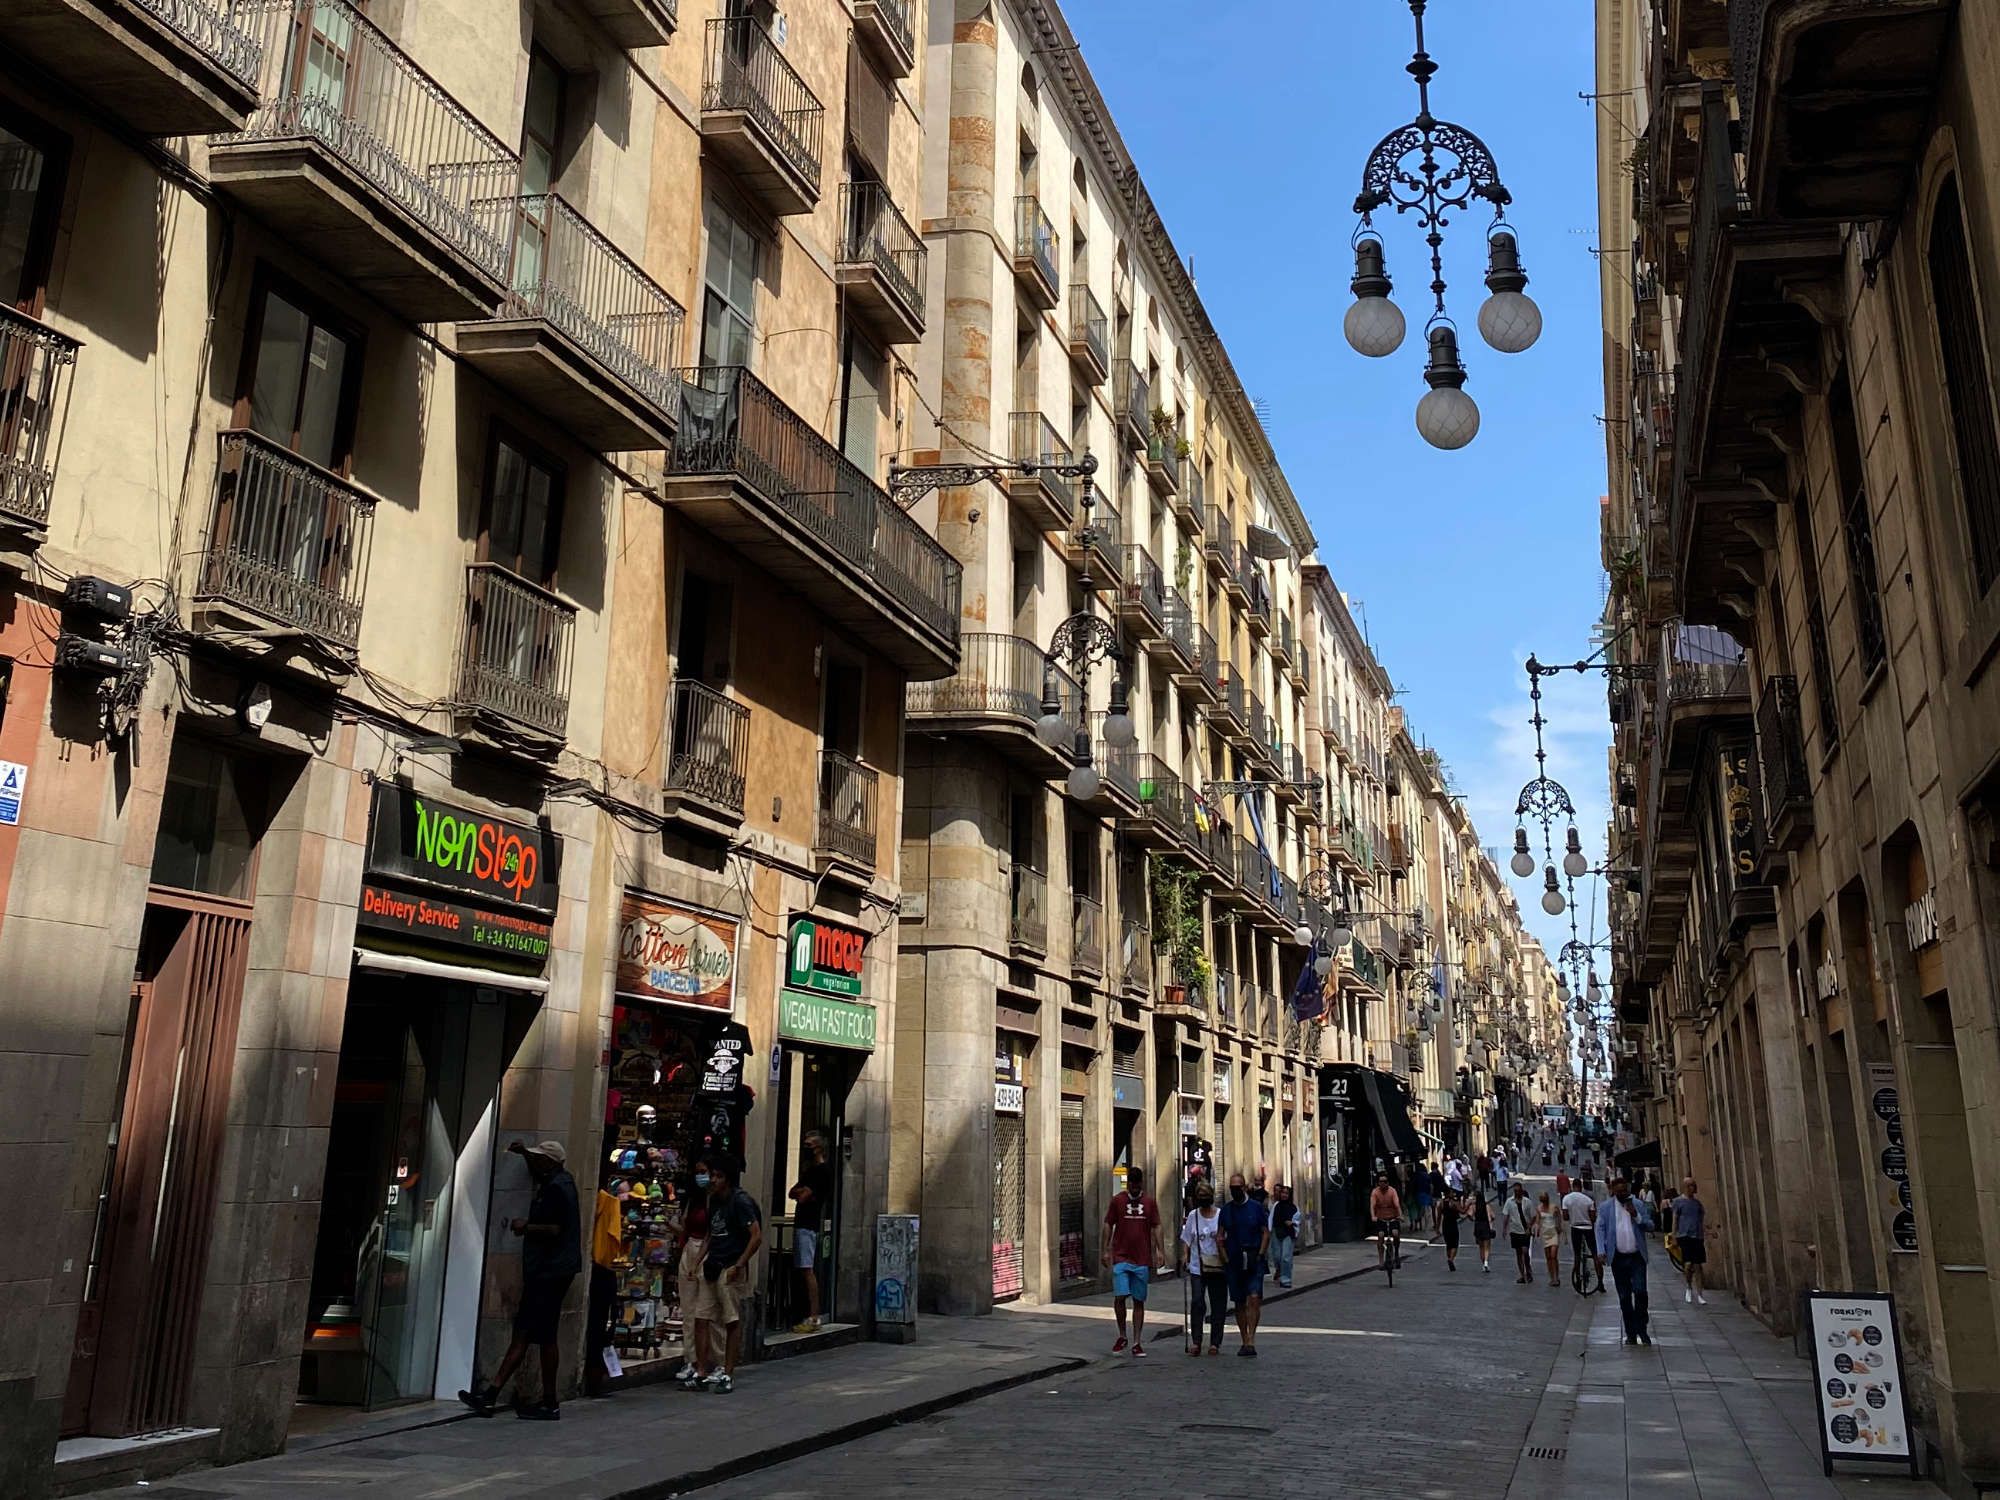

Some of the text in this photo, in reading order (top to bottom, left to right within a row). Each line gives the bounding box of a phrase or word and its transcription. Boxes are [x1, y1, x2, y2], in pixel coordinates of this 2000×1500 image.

[364, 888, 460, 930] Delivery Service
[473, 926, 485, 942] Tel
[487, 930, 503, 947] +34
[621, 924, 730, 978] Cotton Corner
[784, 1000, 820, 1033] VEGAN
[820, 1007, 848, 1038] FAST
